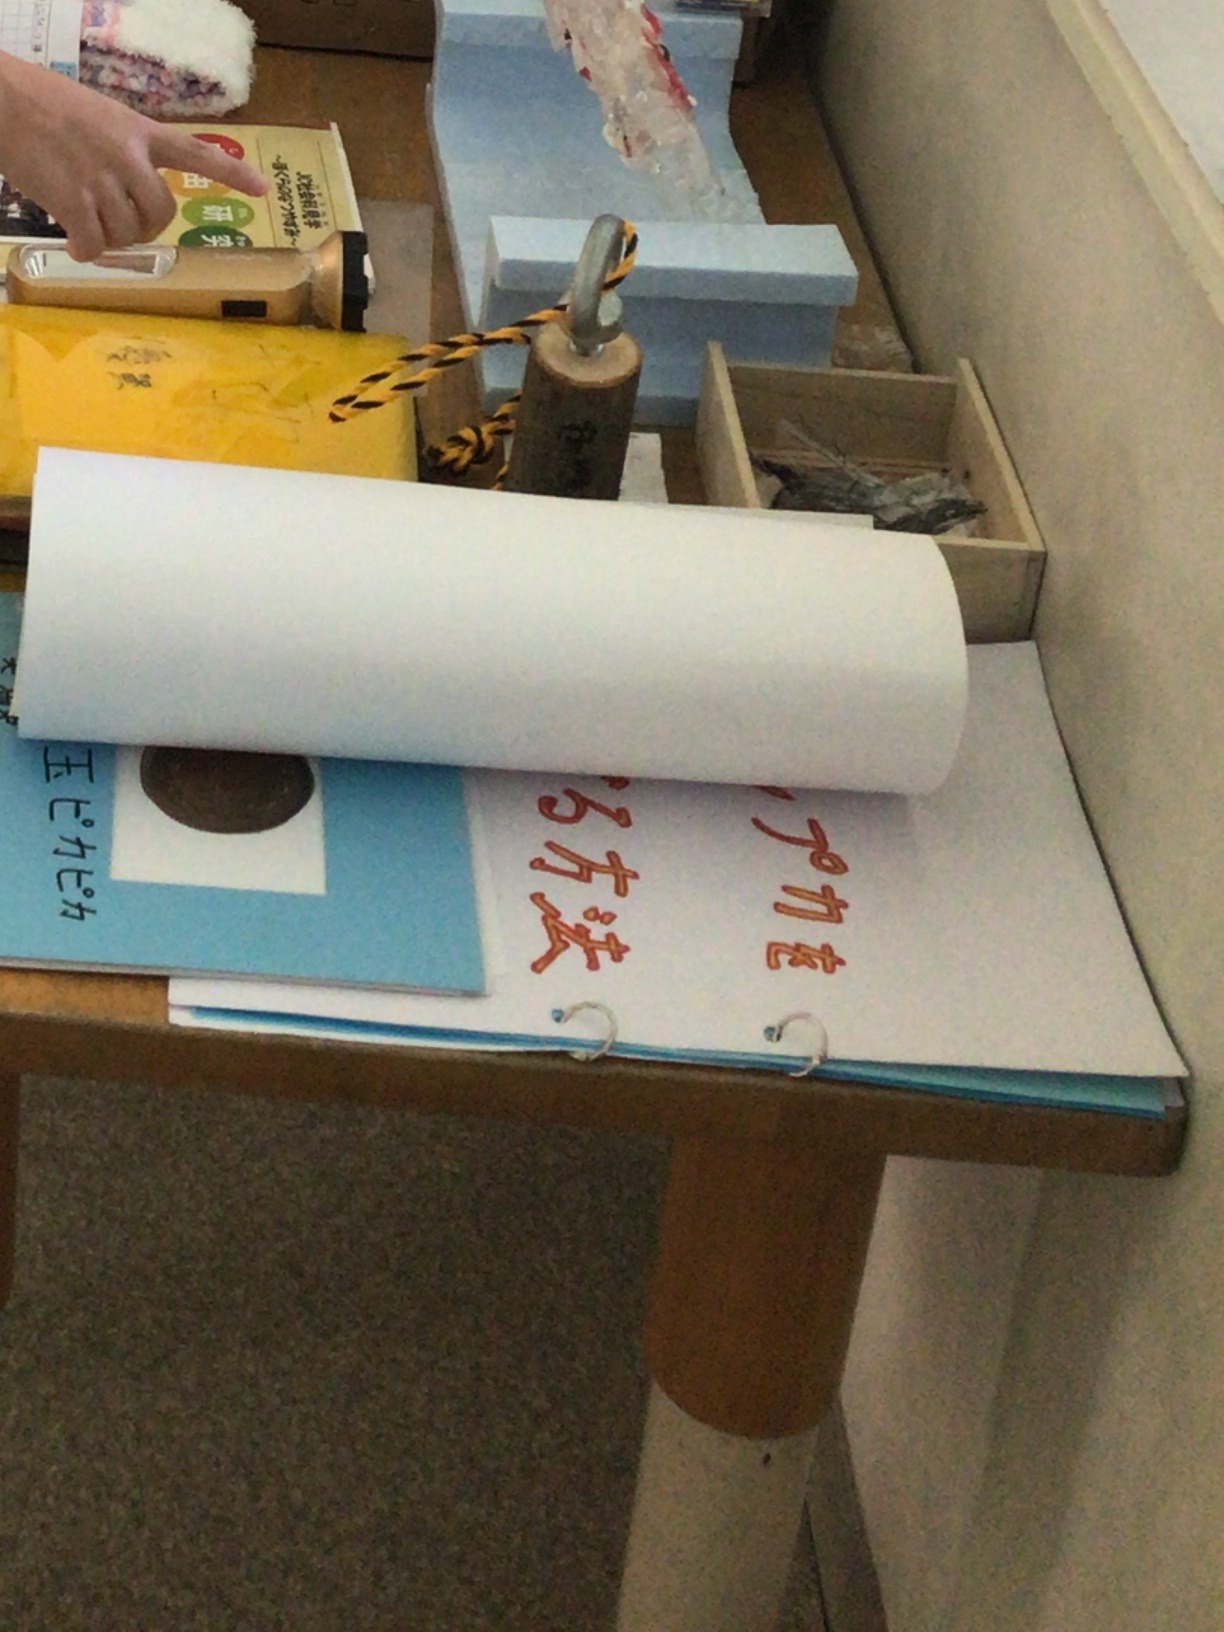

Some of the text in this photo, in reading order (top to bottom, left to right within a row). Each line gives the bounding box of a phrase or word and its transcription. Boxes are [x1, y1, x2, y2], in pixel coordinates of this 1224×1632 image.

[43, 745, 98, 923] 玉ピカピカ
[529, 777, 641, 975] る方法
